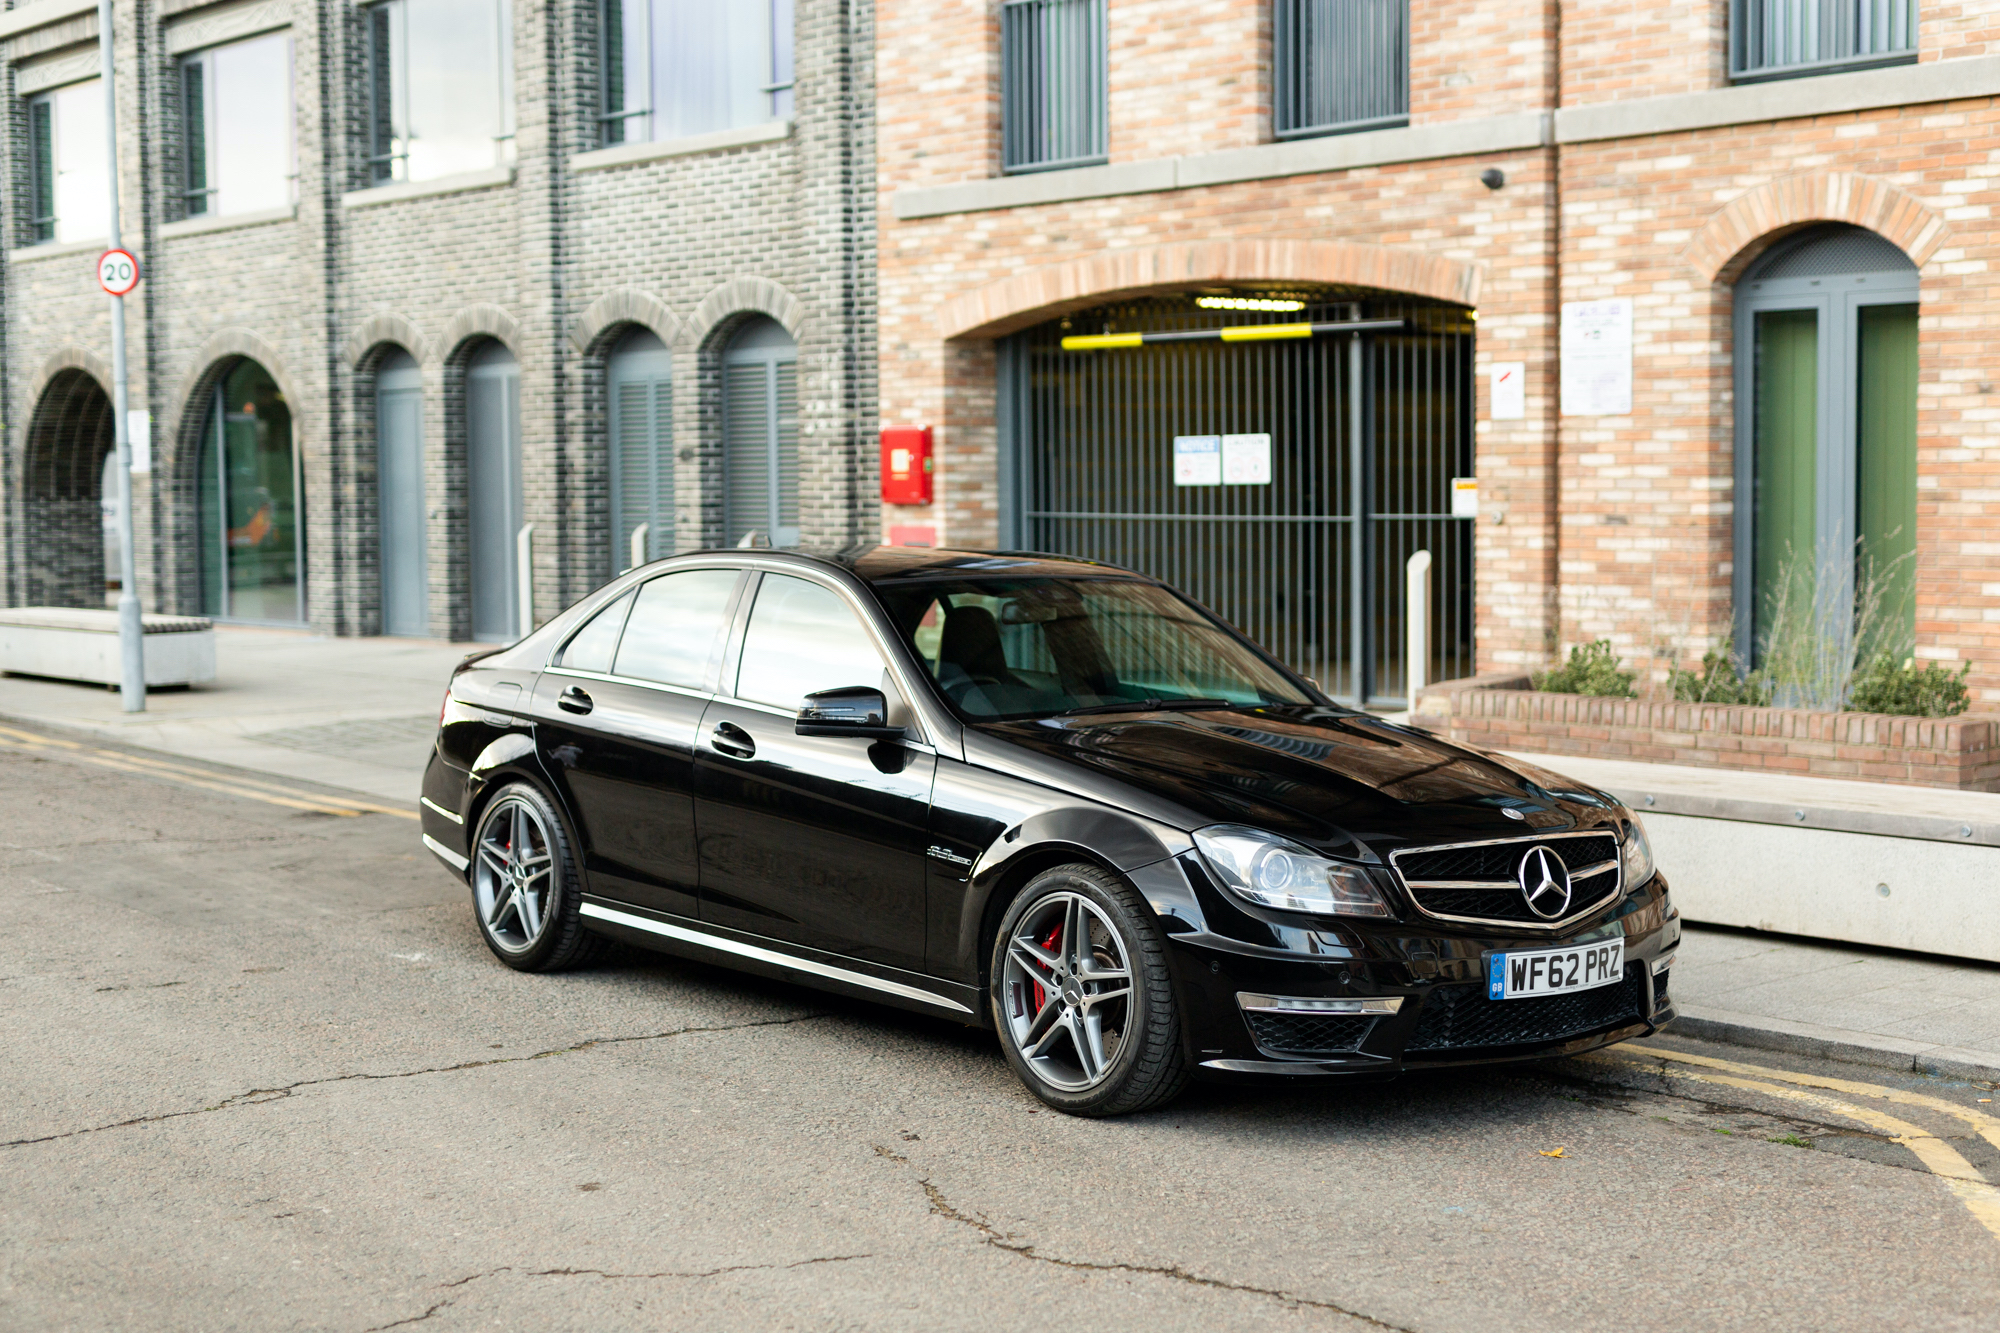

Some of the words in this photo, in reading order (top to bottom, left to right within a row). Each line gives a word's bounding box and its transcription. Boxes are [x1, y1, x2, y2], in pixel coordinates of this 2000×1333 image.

[104, 263, 131, 281] 20
[1511, 953, 1579, 991] WF62
[1585, 945, 1621, 982] PRZ
[1492, 983, 1503, 992] GB
